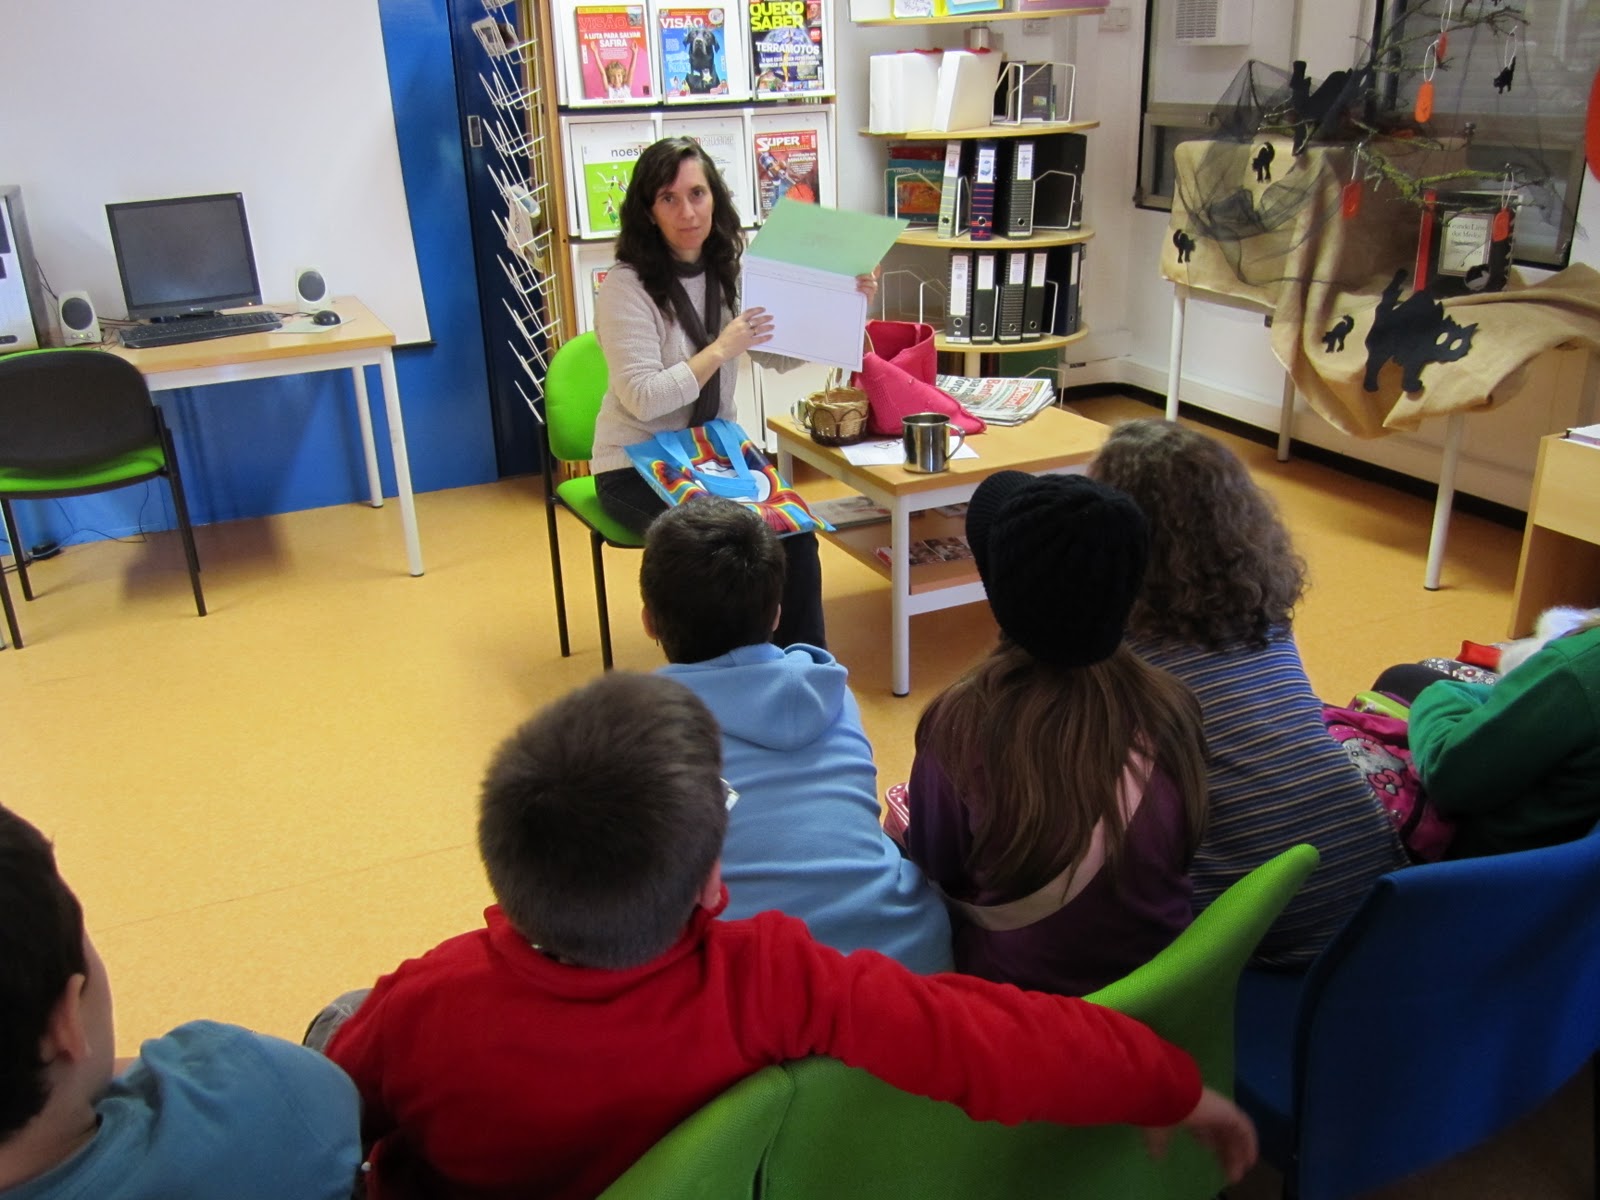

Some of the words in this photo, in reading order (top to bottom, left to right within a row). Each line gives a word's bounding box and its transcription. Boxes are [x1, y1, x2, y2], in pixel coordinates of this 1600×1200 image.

[750, 1, 804, 17] QUERO
[579, 14, 627, 30] VISÃO
[659, 15, 703, 29] VISÃO
[750, 15, 804, 32] SABER
[599, 39, 627, 48] SAFIRA
[755, 42, 820, 55] TERRAMOTOS
[756, 135, 800, 152] SUPER
